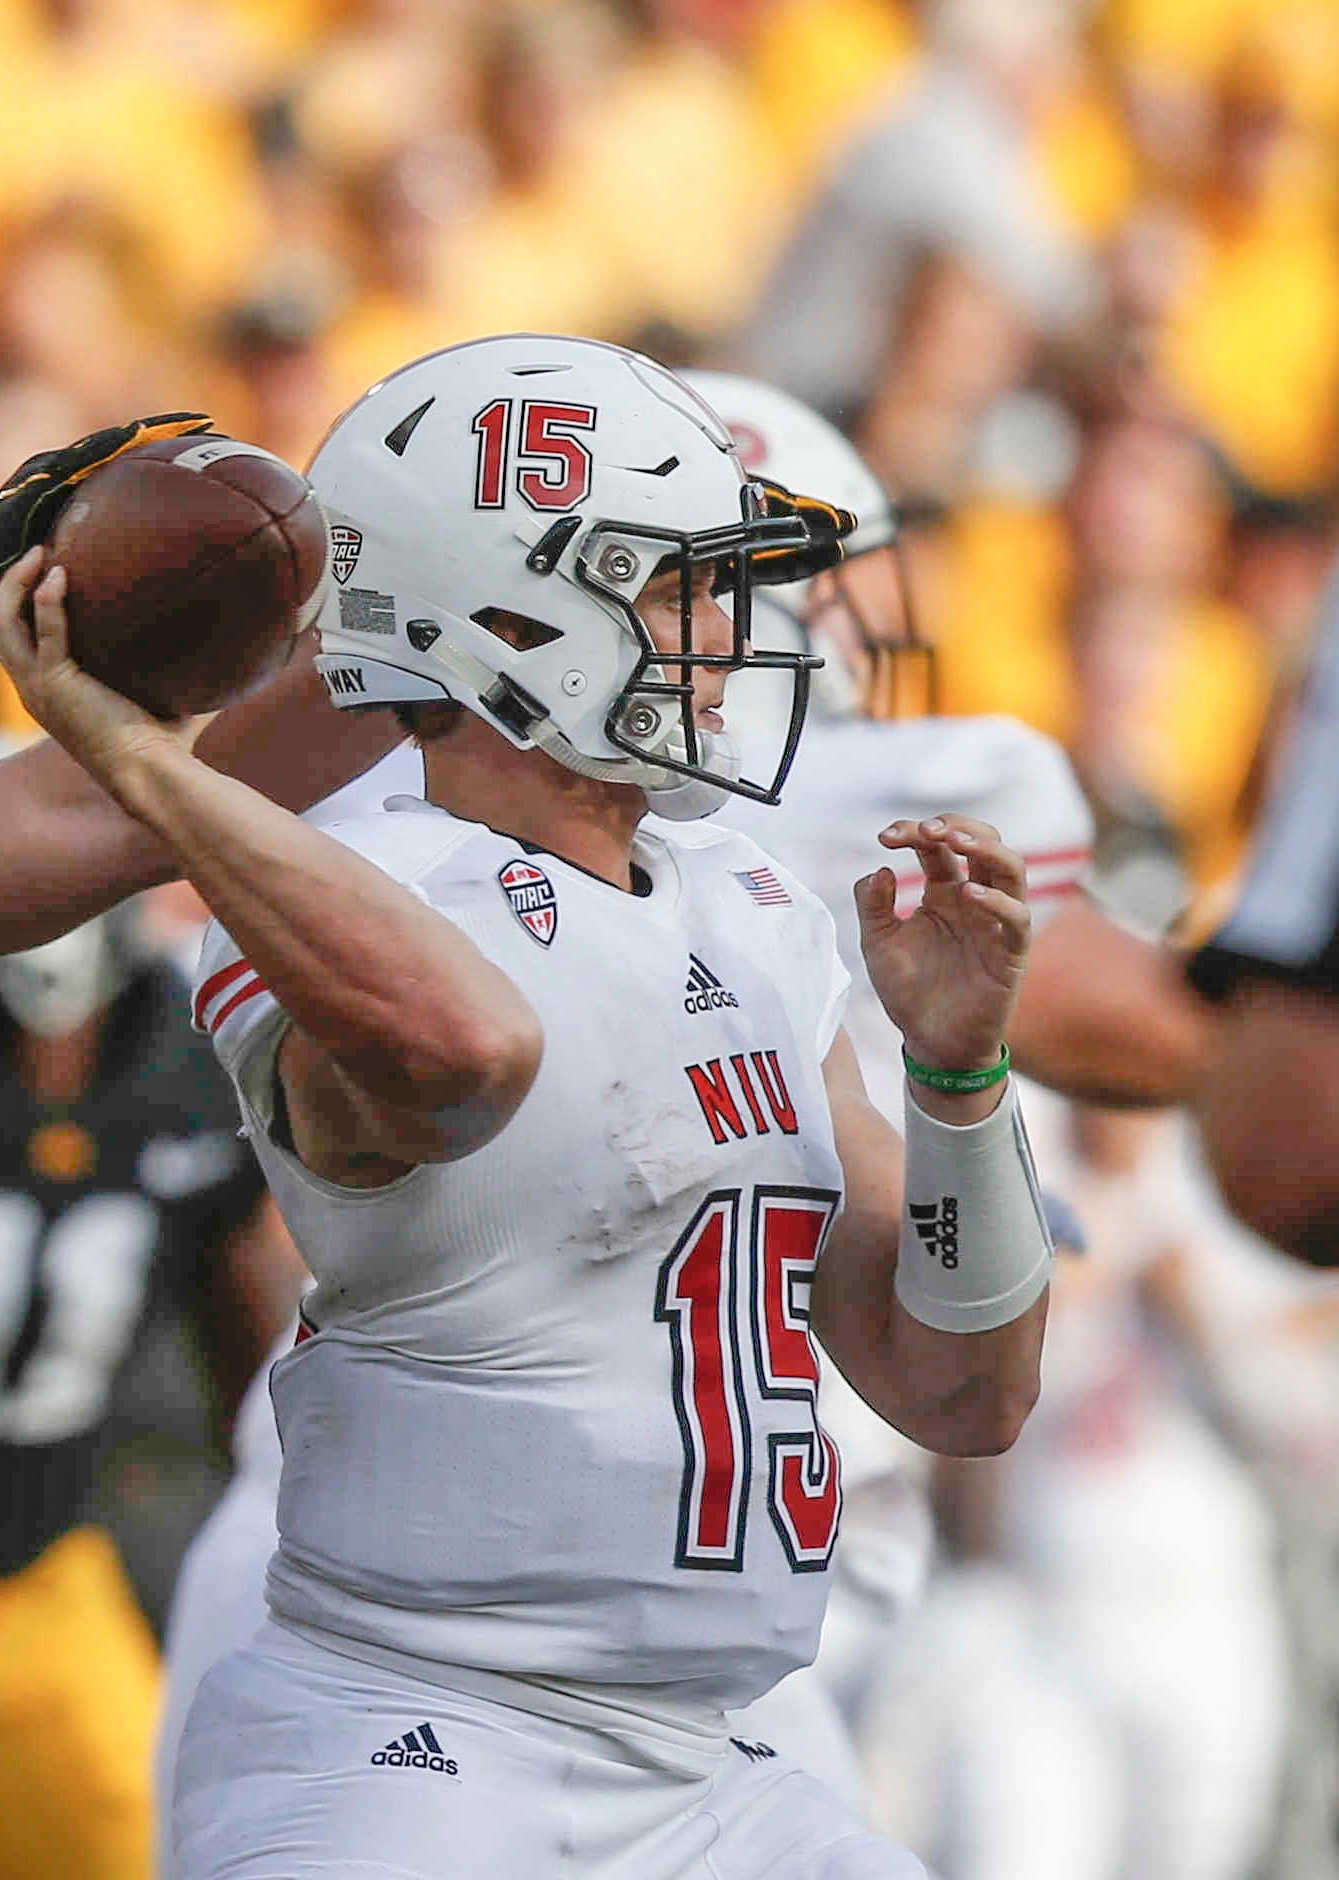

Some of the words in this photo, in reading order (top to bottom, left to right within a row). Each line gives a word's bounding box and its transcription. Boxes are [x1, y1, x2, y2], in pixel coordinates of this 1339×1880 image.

[471, 398, 597, 514] 15
[327, 668, 367, 695] WAY
[507, 883, 556, 912] MAC
[684, 986, 740, 1015] adidas
[684, 1049, 799, 1146] NIU
[936, 1196, 959, 1269] adidas
[654, 1184, 842, 1573] 15
[370, 1749, 459, 1776] adidas
